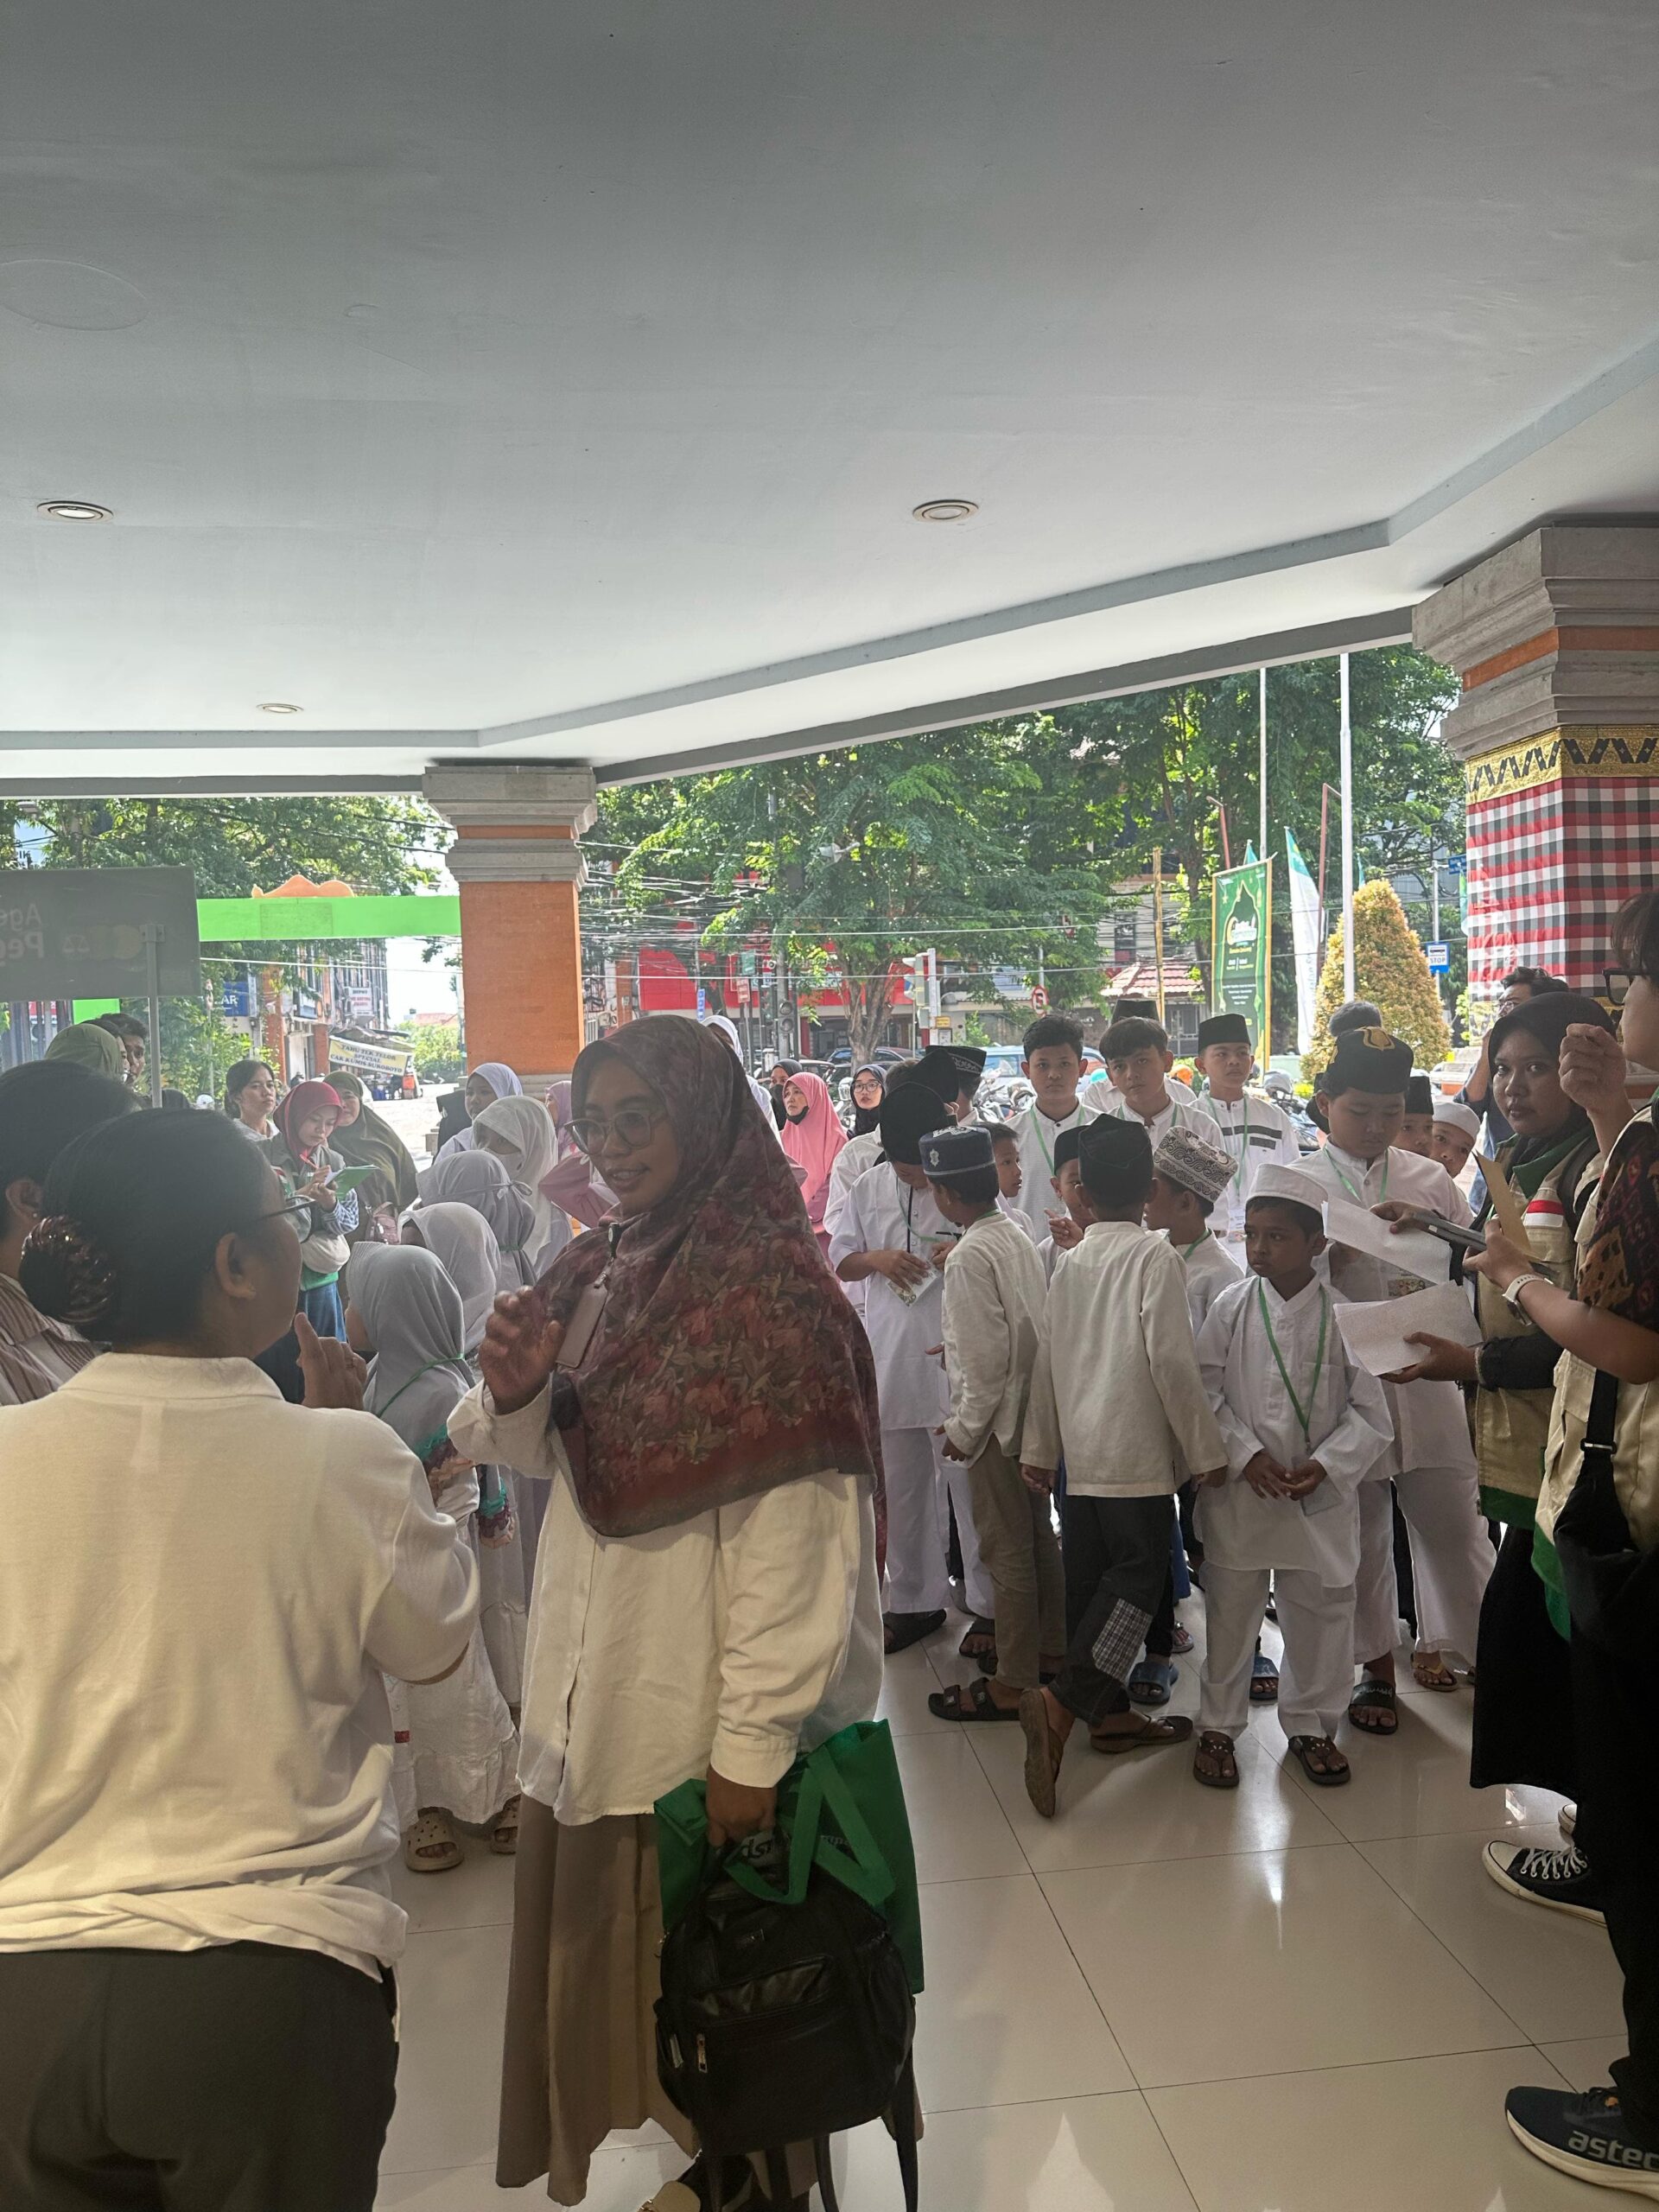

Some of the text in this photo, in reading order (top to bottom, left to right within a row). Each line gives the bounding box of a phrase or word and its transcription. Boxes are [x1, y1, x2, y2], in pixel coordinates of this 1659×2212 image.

[341, 1045, 397, 1061] TAHU TEK TELOR
[354, 1053, 381, 1063] SPECIAL
[345, 1057, 366, 1066] KUMIS
[368, 1062, 402, 1072] SUROBOYO
